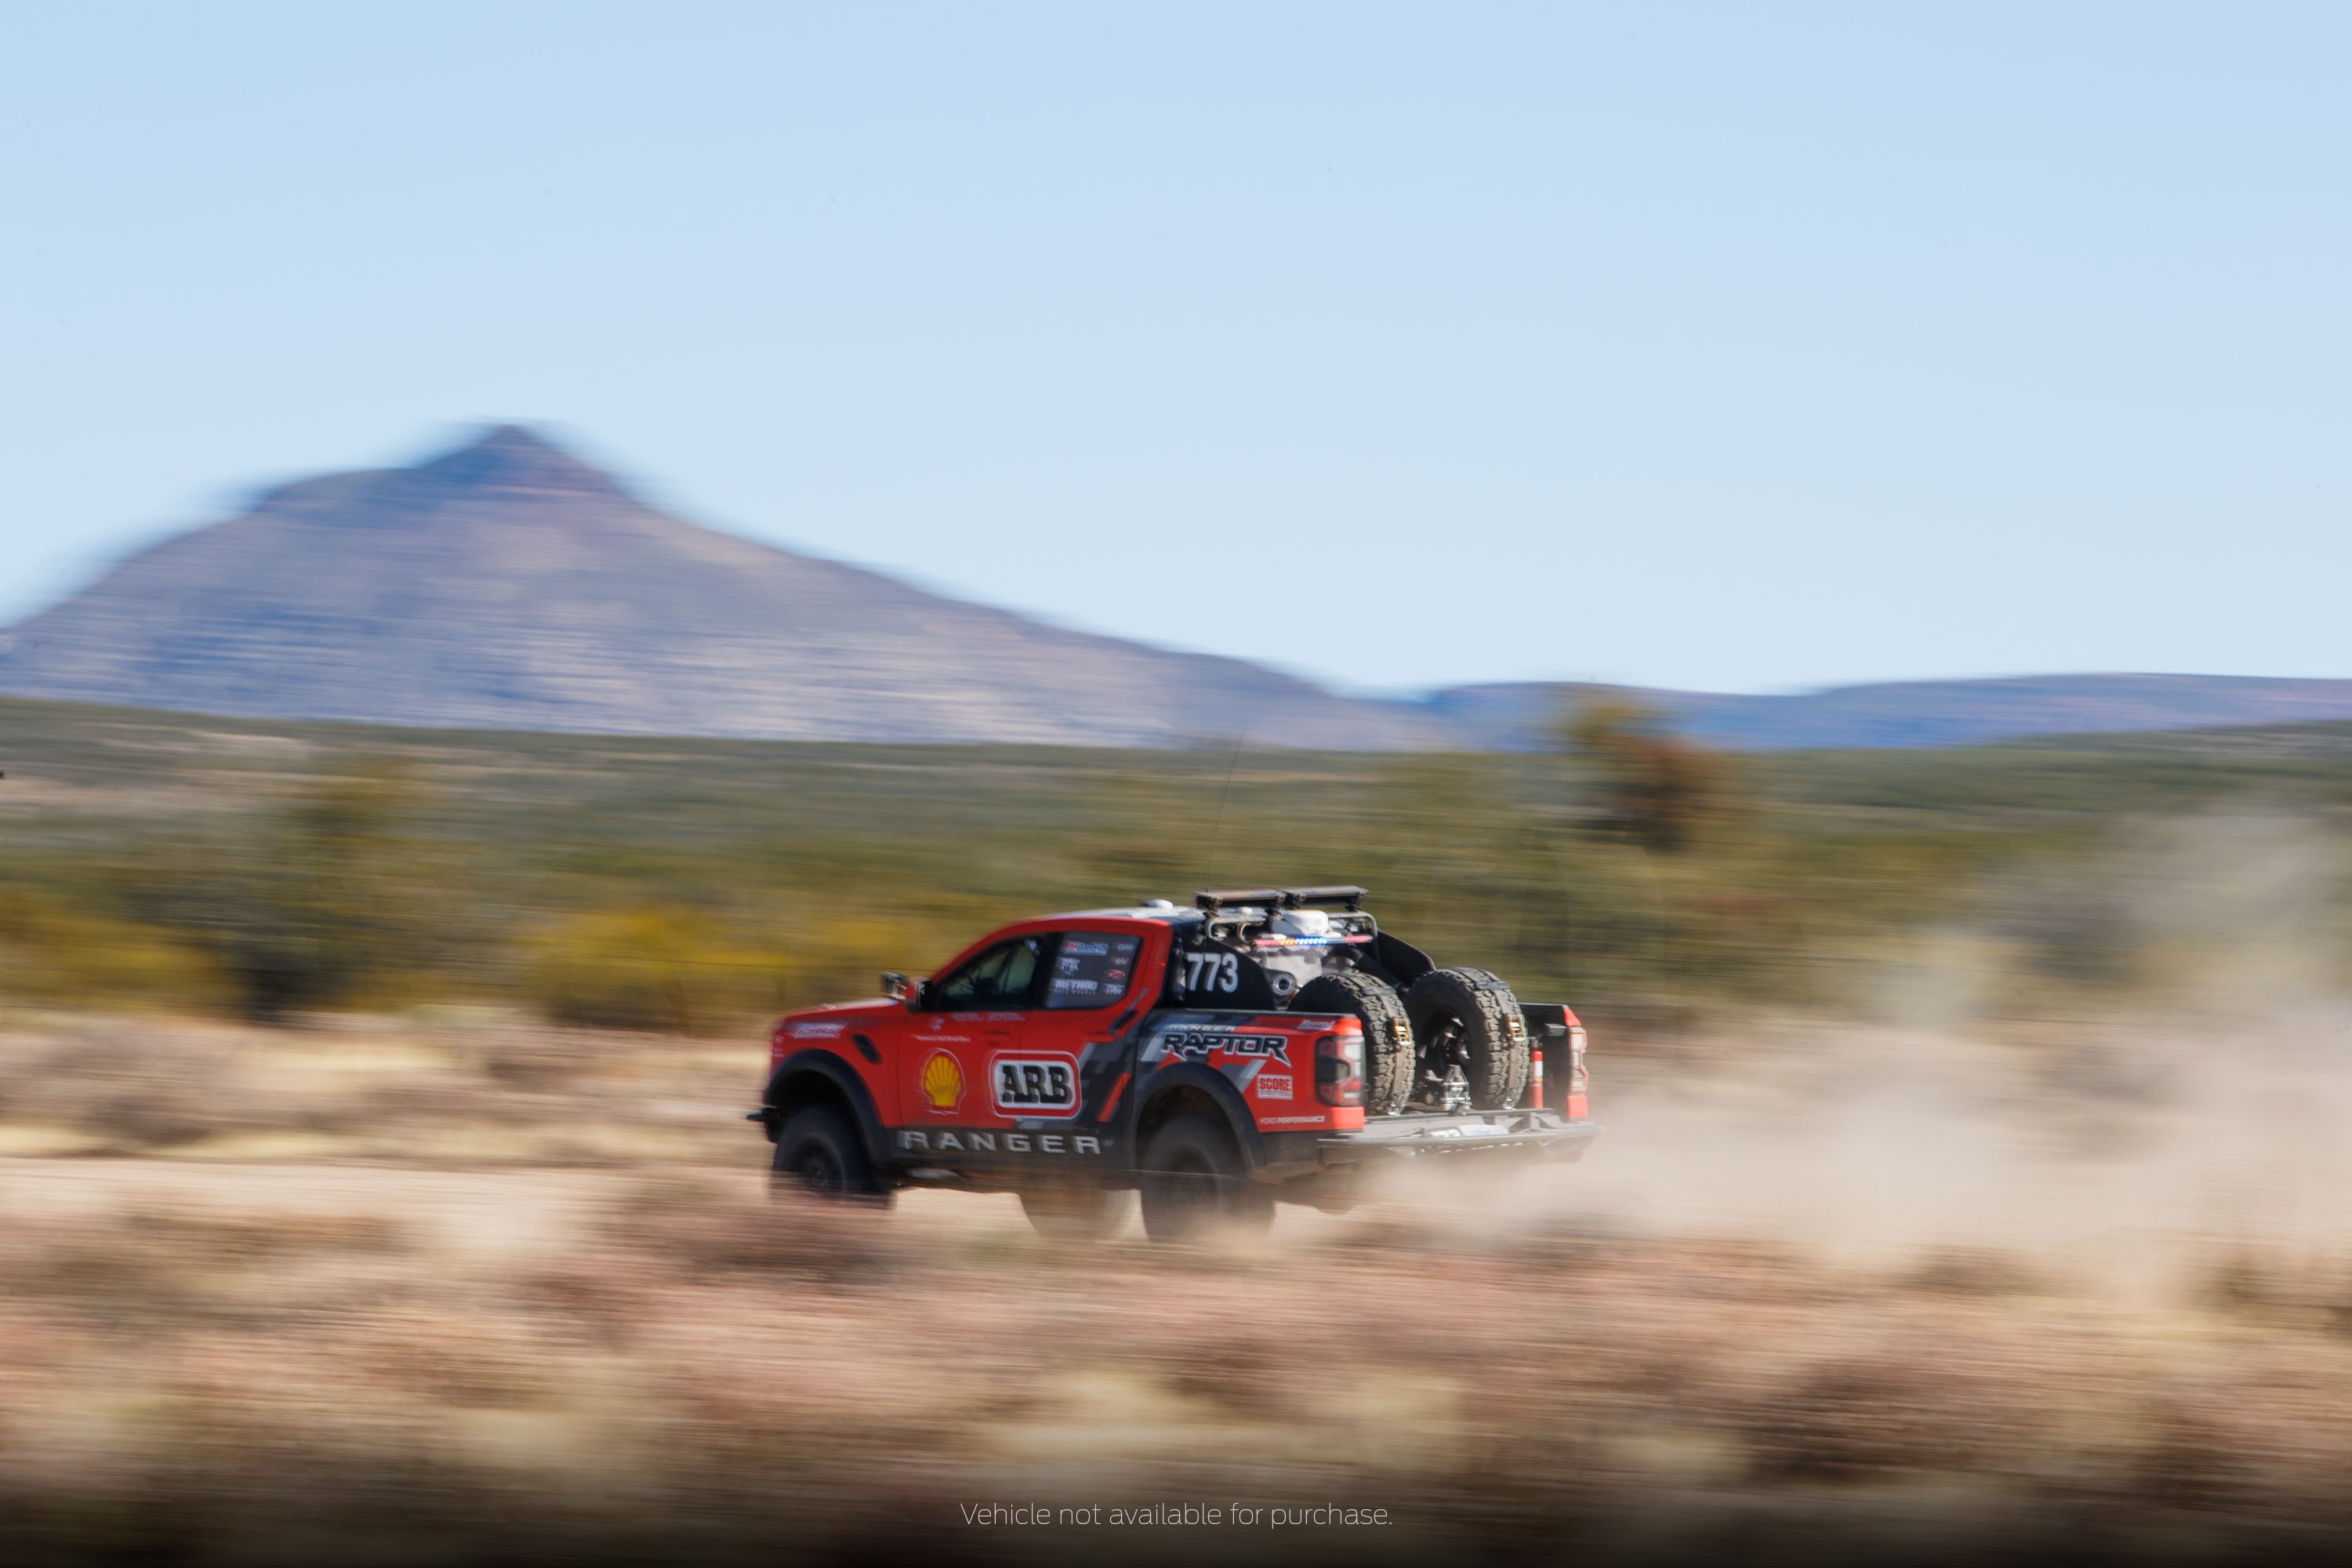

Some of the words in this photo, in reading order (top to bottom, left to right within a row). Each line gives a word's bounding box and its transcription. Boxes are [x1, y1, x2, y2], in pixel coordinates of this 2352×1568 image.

[1054, 979, 1098, 991] METHOD
[1185, 953, 1238, 993] 773
[1163, 1032, 1292, 1068] RAPTOR
[1002, 1064, 1073, 1104] ARB
[1260, 1077, 1291, 1092] SCORE
[1278, 1115, 1326, 1123] PERFORMANCE
[899, 1130, 1101, 1154] RANGER
